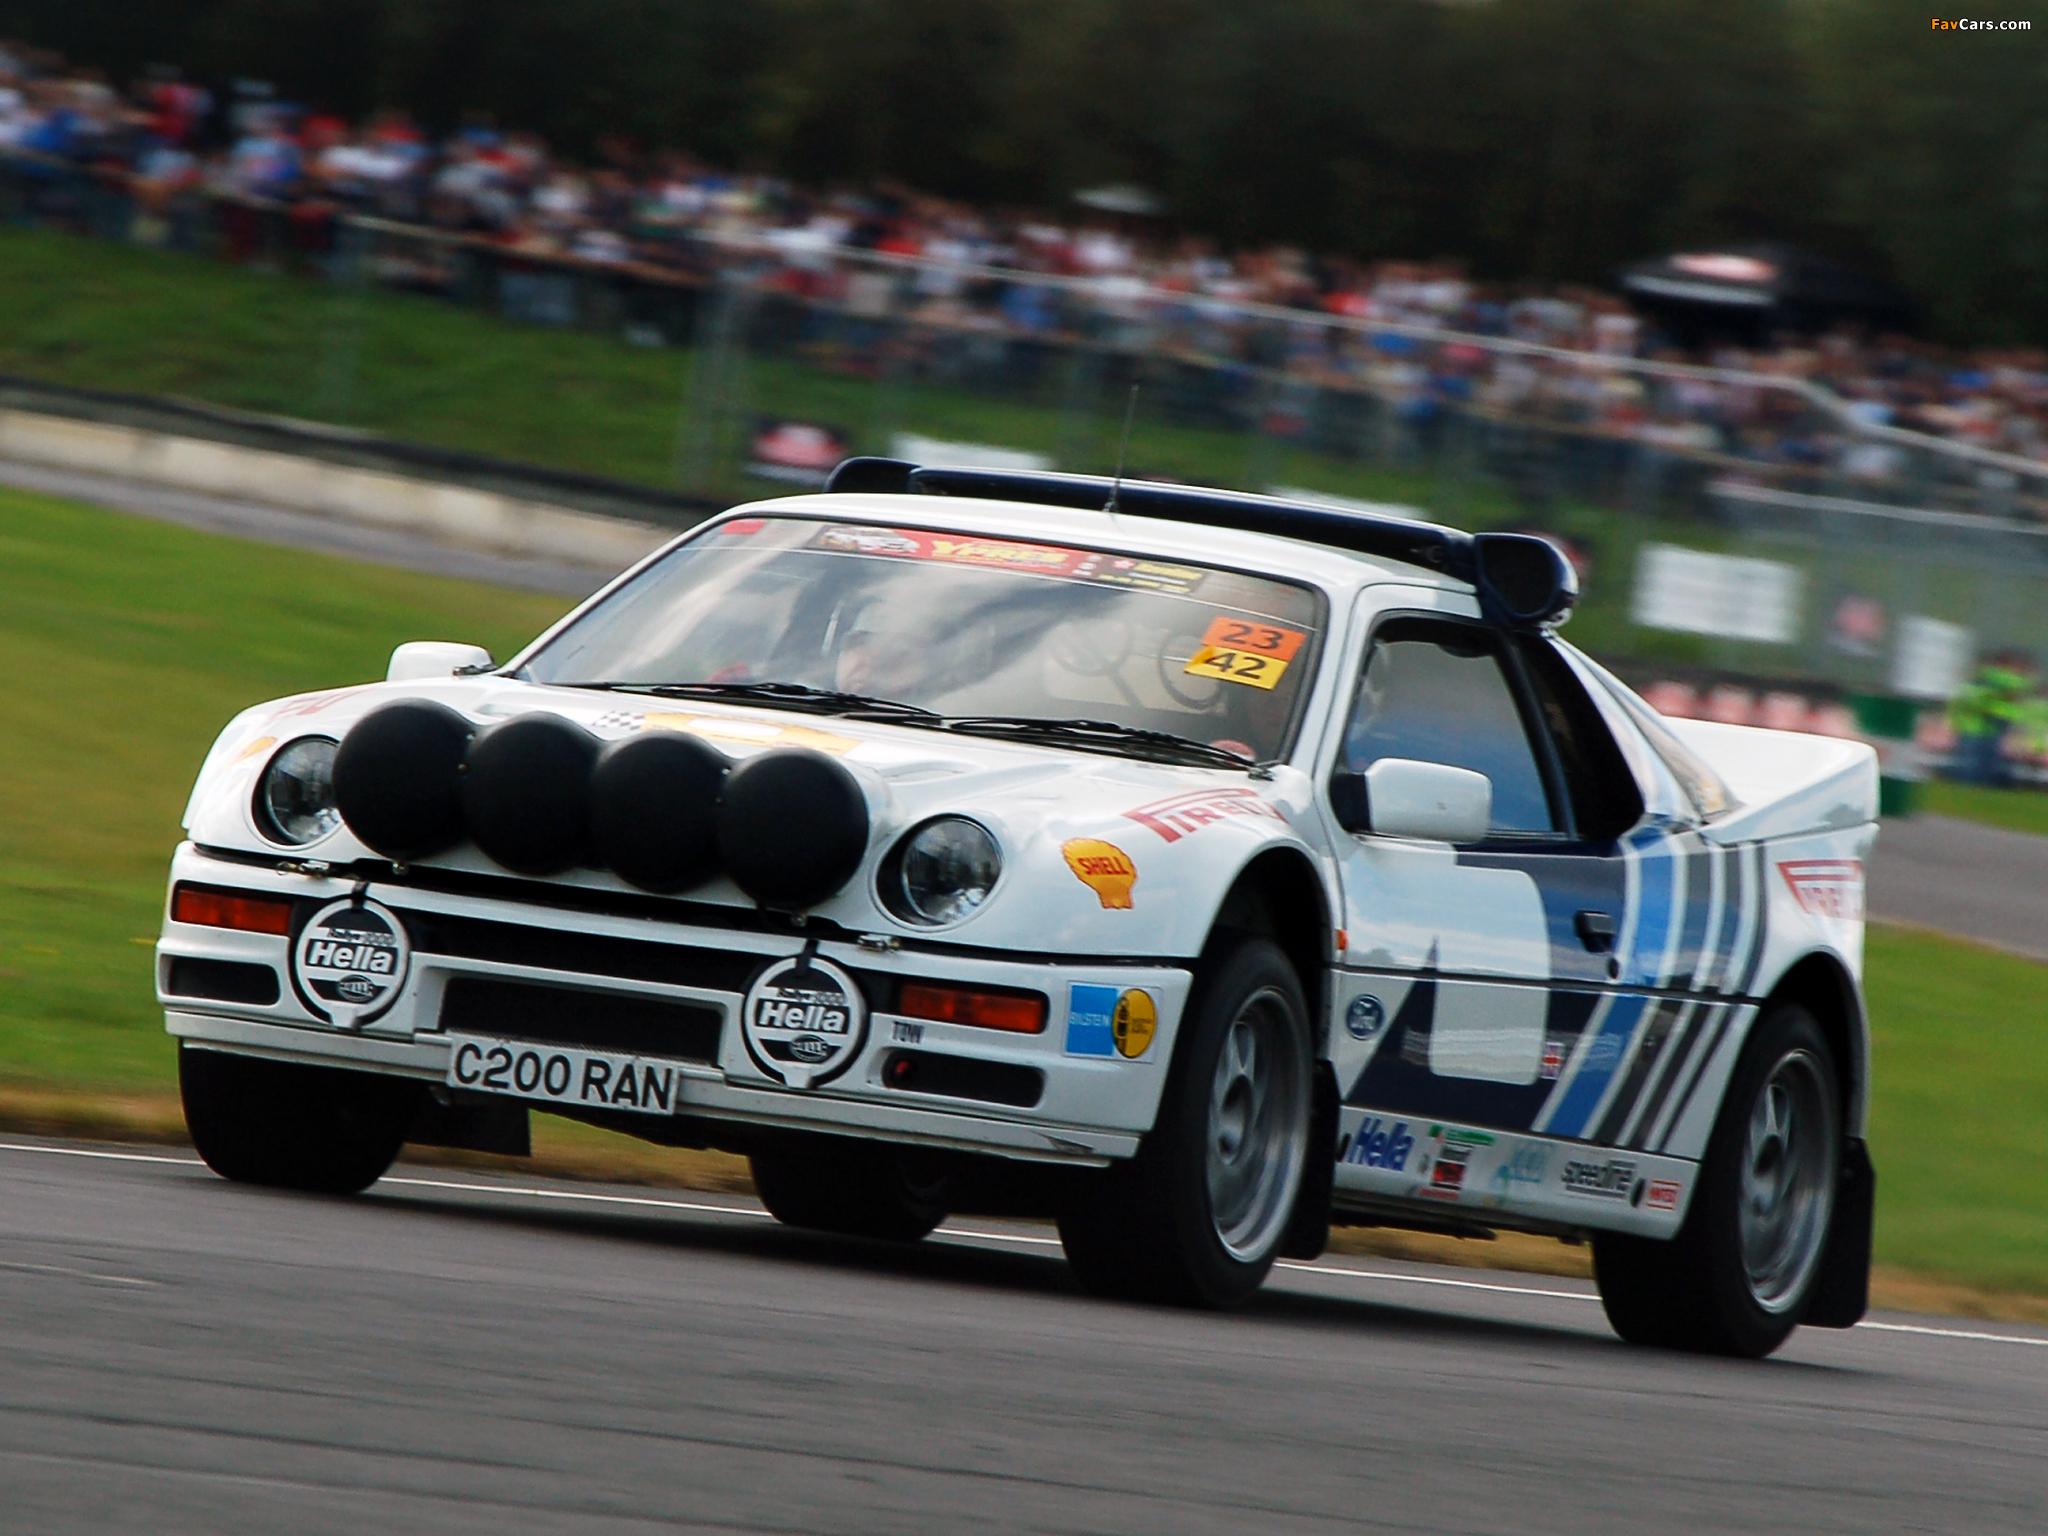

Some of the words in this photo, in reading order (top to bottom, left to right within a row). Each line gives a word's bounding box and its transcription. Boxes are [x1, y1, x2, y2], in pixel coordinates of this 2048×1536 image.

[1219, 622, 1284, 650] 23
[1205, 652, 1267, 680] 42
[1076, 856, 1130, 876] SHELL
[308, 938, 393, 973] Hella
[758, 1000, 846, 1032] Hella
[1068, 1011, 1112, 1028] BILSTEIN
[455, 1043, 571, 1096] C200
[581, 1058, 673, 1110] RAN
[1346, 1116, 1416, 1172] Hella
